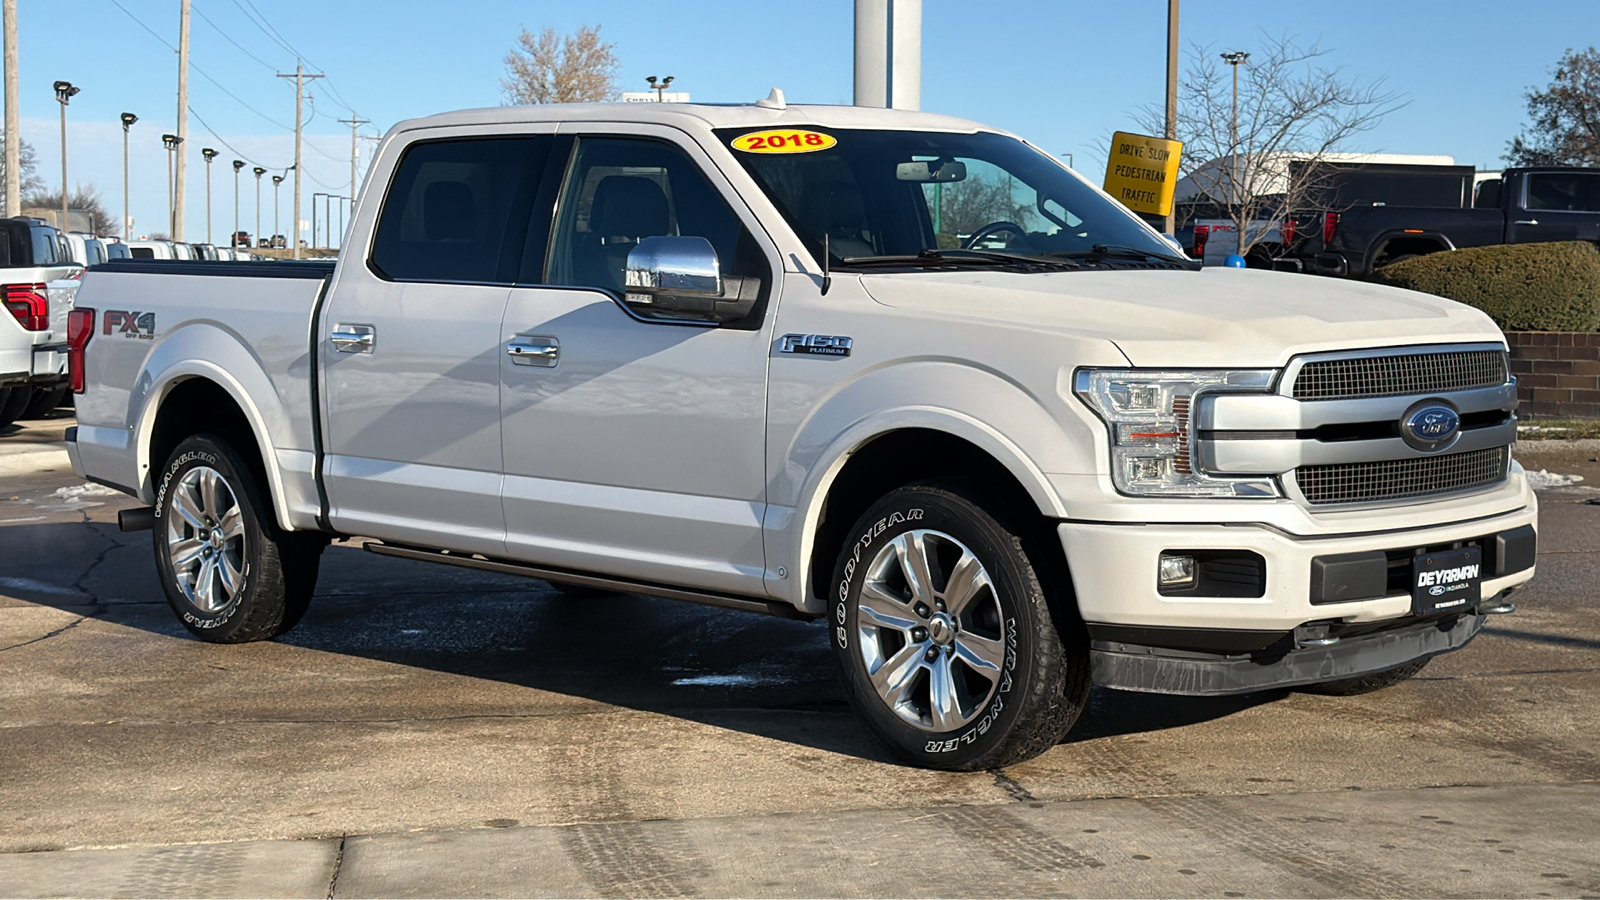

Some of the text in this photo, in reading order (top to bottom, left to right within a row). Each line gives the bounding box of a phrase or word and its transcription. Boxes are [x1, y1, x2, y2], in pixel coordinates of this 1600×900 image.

[746, 133, 824, 150] 2018
[1120, 144, 1170, 161] DRIVE SLOW
[1115, 165, 1166, 183] PEDESTRIAN
[1121, 188, 1155, 203] TRAFFIC
[103, 310, 155, 335] FX4
[809, 347, 845, 355] PLATINUM
[1422, 413, 1451, 434] Ford
[154, 451, 216, 518] WRANGLER
[837, 508, 924, 649] GOODYEAR
[1418, 564, 1479, 587] DEYARMAN
[924, 617, 1016, 753] WRANGLER
